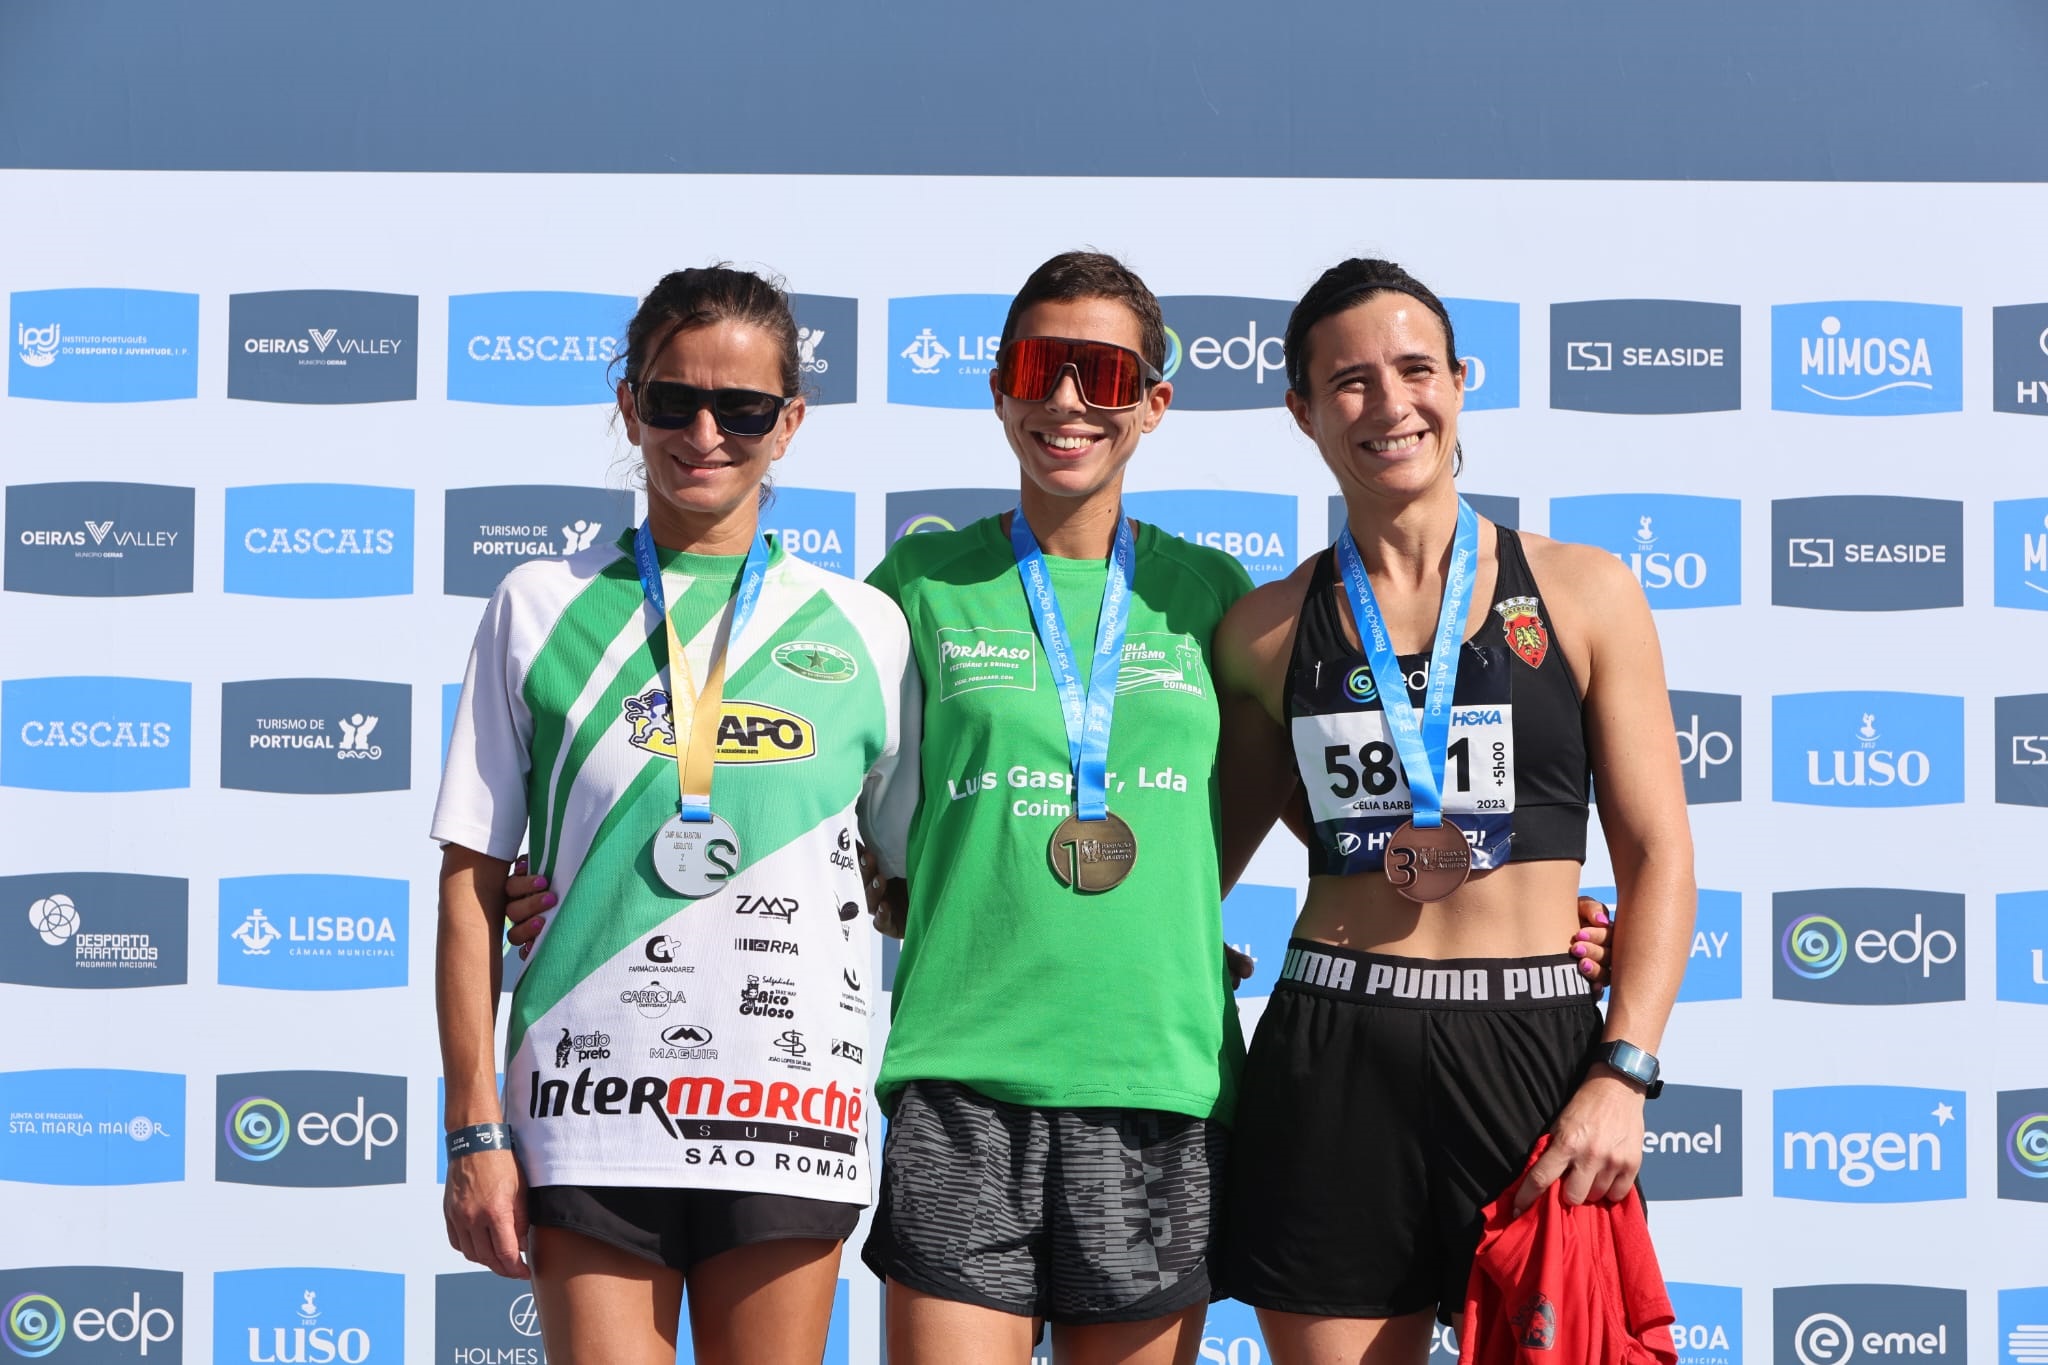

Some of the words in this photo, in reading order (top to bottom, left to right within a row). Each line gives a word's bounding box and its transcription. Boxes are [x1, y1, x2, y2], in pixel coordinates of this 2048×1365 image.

[62, 336, 100, 344] INSTITUTO
[244, 338, 309, 354] OEIRAS
[336, 339, 402, 354] VALLEY
[467, 335, 617, 362] CASCAIS
[958, 335, 1002, 361] LIS
[1190, 321, 1286, 384] edp
[1622, 347, 1724, 367] SEASIDE
[958, 366, 988, 375] CÂMA
[20, 530, 86, 546] OEIRAS
[112, 531, 178, 547] VALLEY
[480, 525, 532, 537] TURISMO
[533, 526, 548, 537] DE
[244, 527, 395, 555] CASCAIS
[473, 541, 557, 556] PORTUGAL
[1178, 532, 1285, 558] ISBOA
[1844, 544, 1946, 563] SEASIDE
[1244, 564, 1284, 572] NICIPAL
[1100, 604, 1119, 655] FEDERAÇÃO
[1028, 559, 1051, 610] FEDERAÇÃO
[1044, 612, 1070, 670] PORTUGUESA
[1063, 673, 1082, 725] ATLETISMO
[1163, 680, 1202, 696] COIMBRA
[256, 718, 307, 730] TURISMO
[309, 719, 325, 730] DE
[1452, 710, 1503, 727] HOKA
[21, 720, 172, 748] CASCAIS
[249, 735, 334, 750] PORTUGAL
[1675, 714, 1734, 779] dp
[1324, 737, 1471, 799] 581
[1493, 741, 1506, 787] +5h00
[1806, 749, 1931, 787] LUSO
[1007, 765, 1126, 796] Gaspr,
[1138, 766, 1188, 793] Lda
[1476, 799, 1506, 810] 2023
[289, 916, 396, 943] LISBOA
[75, 933, 149, 948] DESPORTO
[770, 940, 799, 956] RPA
[1854, 914, 1957, 978] edp
[75, 946, 158, 960] PARATODOS
[289, 947, 333, 957] CÂMARA
[337, 948, 396, 957] MUNICIPAL
[1283, 948, 1357, 991] UMA
[1365, 963, 1489, 1001] PUMA
[620, 990, 687, 1004] CARROLA
[757, 990, 790, 1006] Bico
[739, 1002, 795, 1020] Guloso
[572, 1030, 611, 1050] gato
[577, 1045, 611, 1064] preto
[649, 1047, 719, 1060] MAGUIR
[10, 1112, 33, 1120] JUNTA
[34, 1112, 45, 1120] DE
[46, 1112, 84, 1120] FREGUESIA
[41, 1121, 93, 1137] MARIA
[297, 1096, 399, 1160] edp
[1642, 1123, 1721, 1155] emel
[684, 1144, 756, 1167] SÃO
[775, 1155, 858, 1181] ROMÃO
[1783, 1131, 1941, 1188] mgen
[73, 1291, 175, 1356] edp
[247, 1327, 371, 1364] LUSO
[1669, 1324, 1729, 1350] BOA
[1862, 1324, 1947, 1356] emel
[455, 1347, 538, 1365] HOLMES
[1680, 1357, 1729, 1365] UNICIPAL
